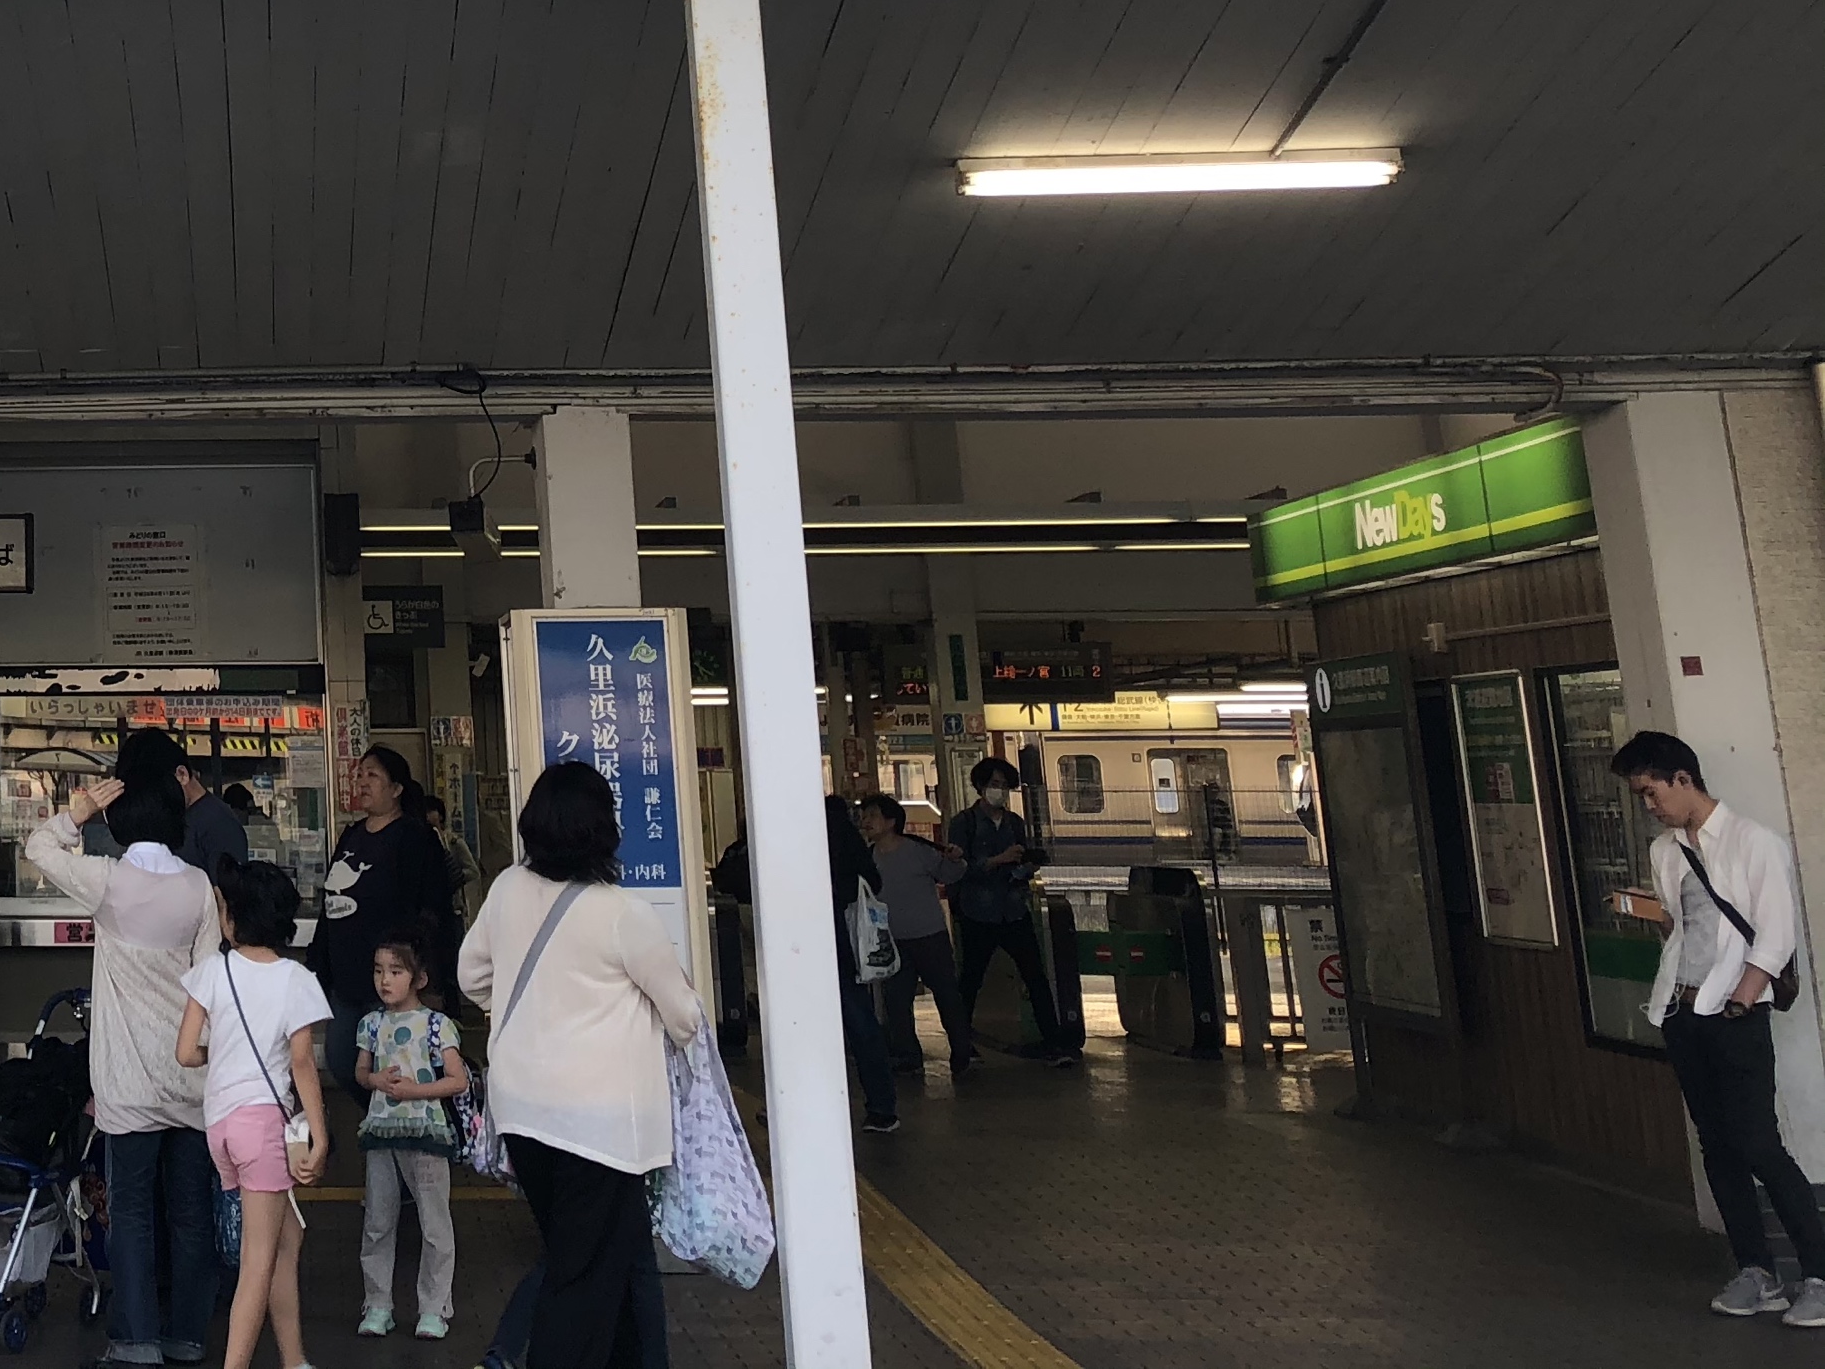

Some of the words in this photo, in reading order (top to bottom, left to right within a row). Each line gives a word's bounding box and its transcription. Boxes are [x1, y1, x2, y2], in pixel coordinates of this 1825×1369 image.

[1354, 490, 1447, 550] NewDays
[1091, 664, 1101, 678] 2
[30, 698, 157, 715] いらっしゃいませ
[349, 707, 363, 757] 大人の休日
[636, 673, 659, 776] 医療法人社団
[894, 712, 930, 730] 病院
[586, 633, 626, 836] 久里浜泌尿
[643, 787, 663, 839] 謙仁会
